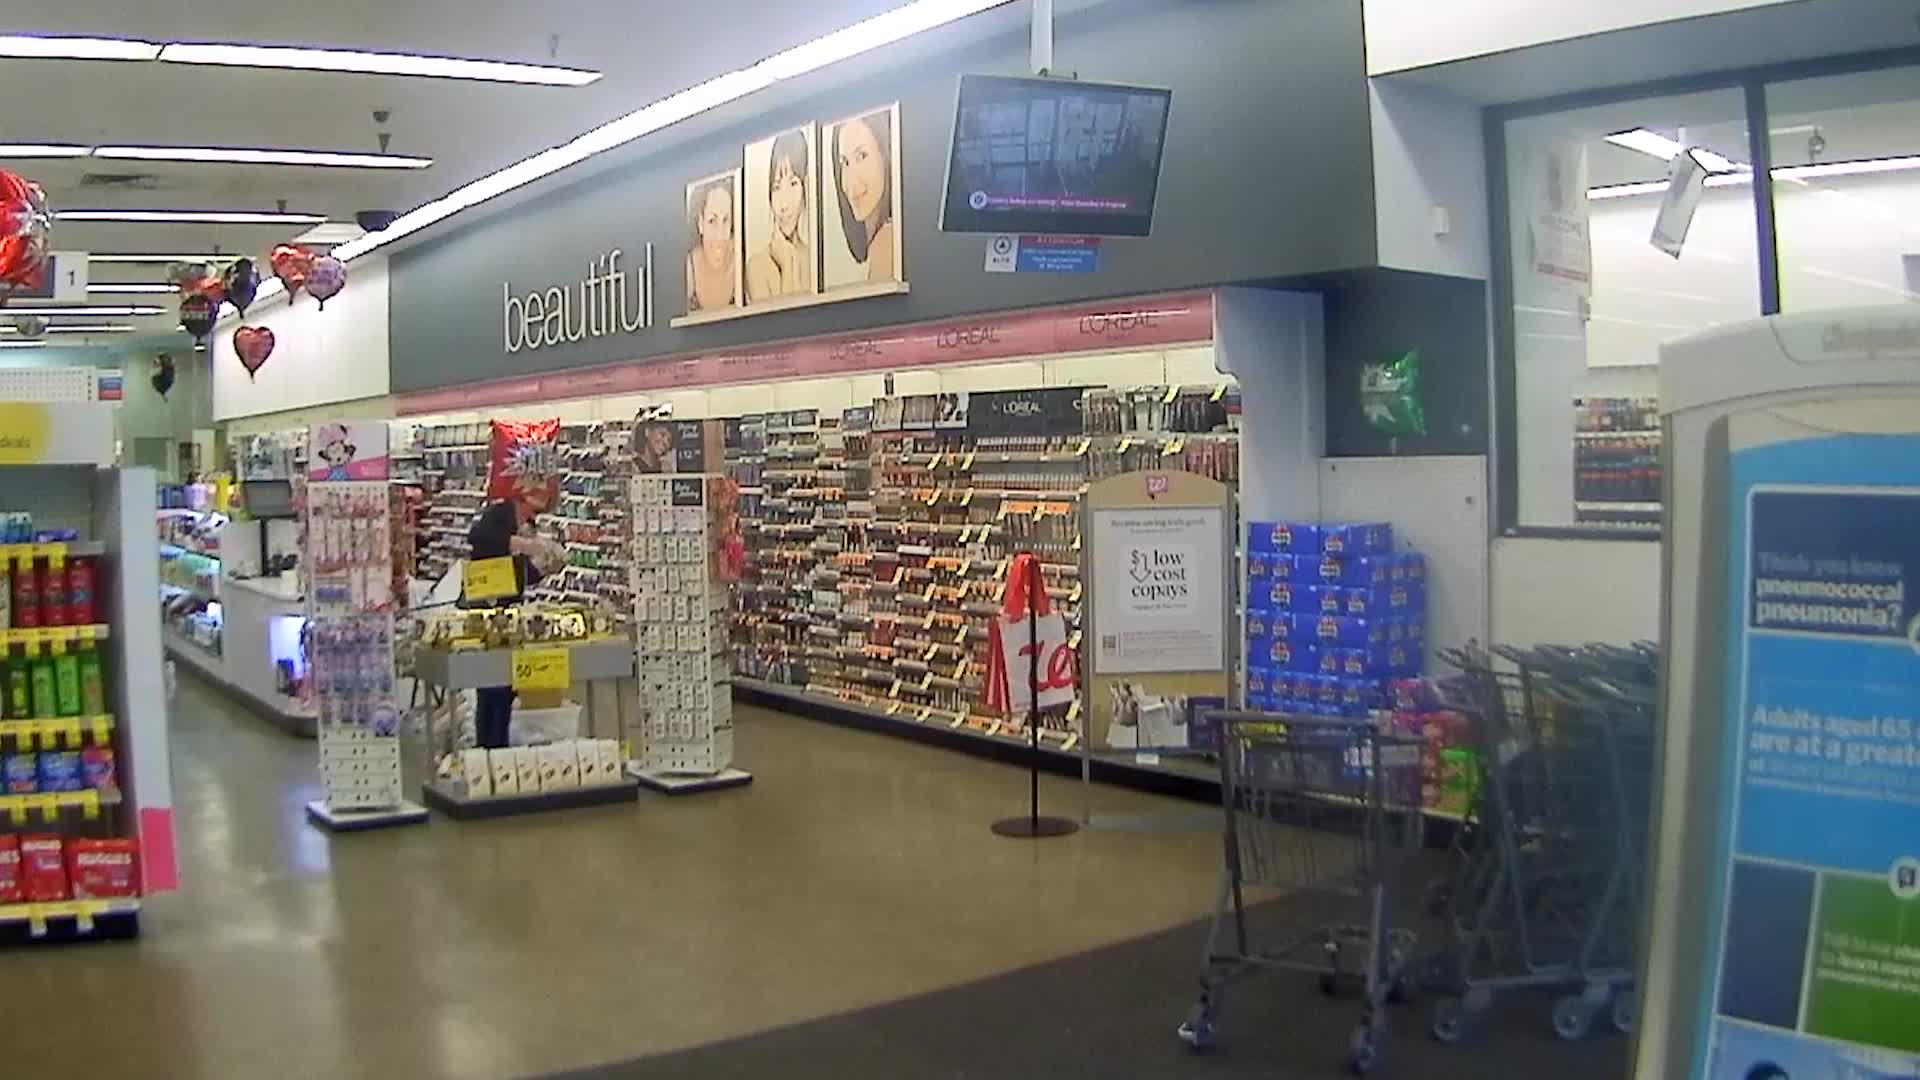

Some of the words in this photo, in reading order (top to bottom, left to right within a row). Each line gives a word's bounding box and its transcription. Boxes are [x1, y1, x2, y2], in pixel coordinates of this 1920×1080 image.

[67, 270, 75, 286] 1
[504, 242, 654, 352] beautiful
[1154, 549, 1184, 566] low
[1154, 568, 1186, 581] cost
[1131, 584, 1188, 601] copays
[1756, 578, 1905, 602] pneumococcal
[1756, 600, 1904, 630] pneumonia?
[1751, 703, 1822, 730] Adults
[1824, 714, 1877, 739] aged
[1882, 715, 1912, 738] 65
[1750, 731, 1790, 753] are
[1793, 736, 1821, 757] at
[1824, 740, 1842, 759] a
